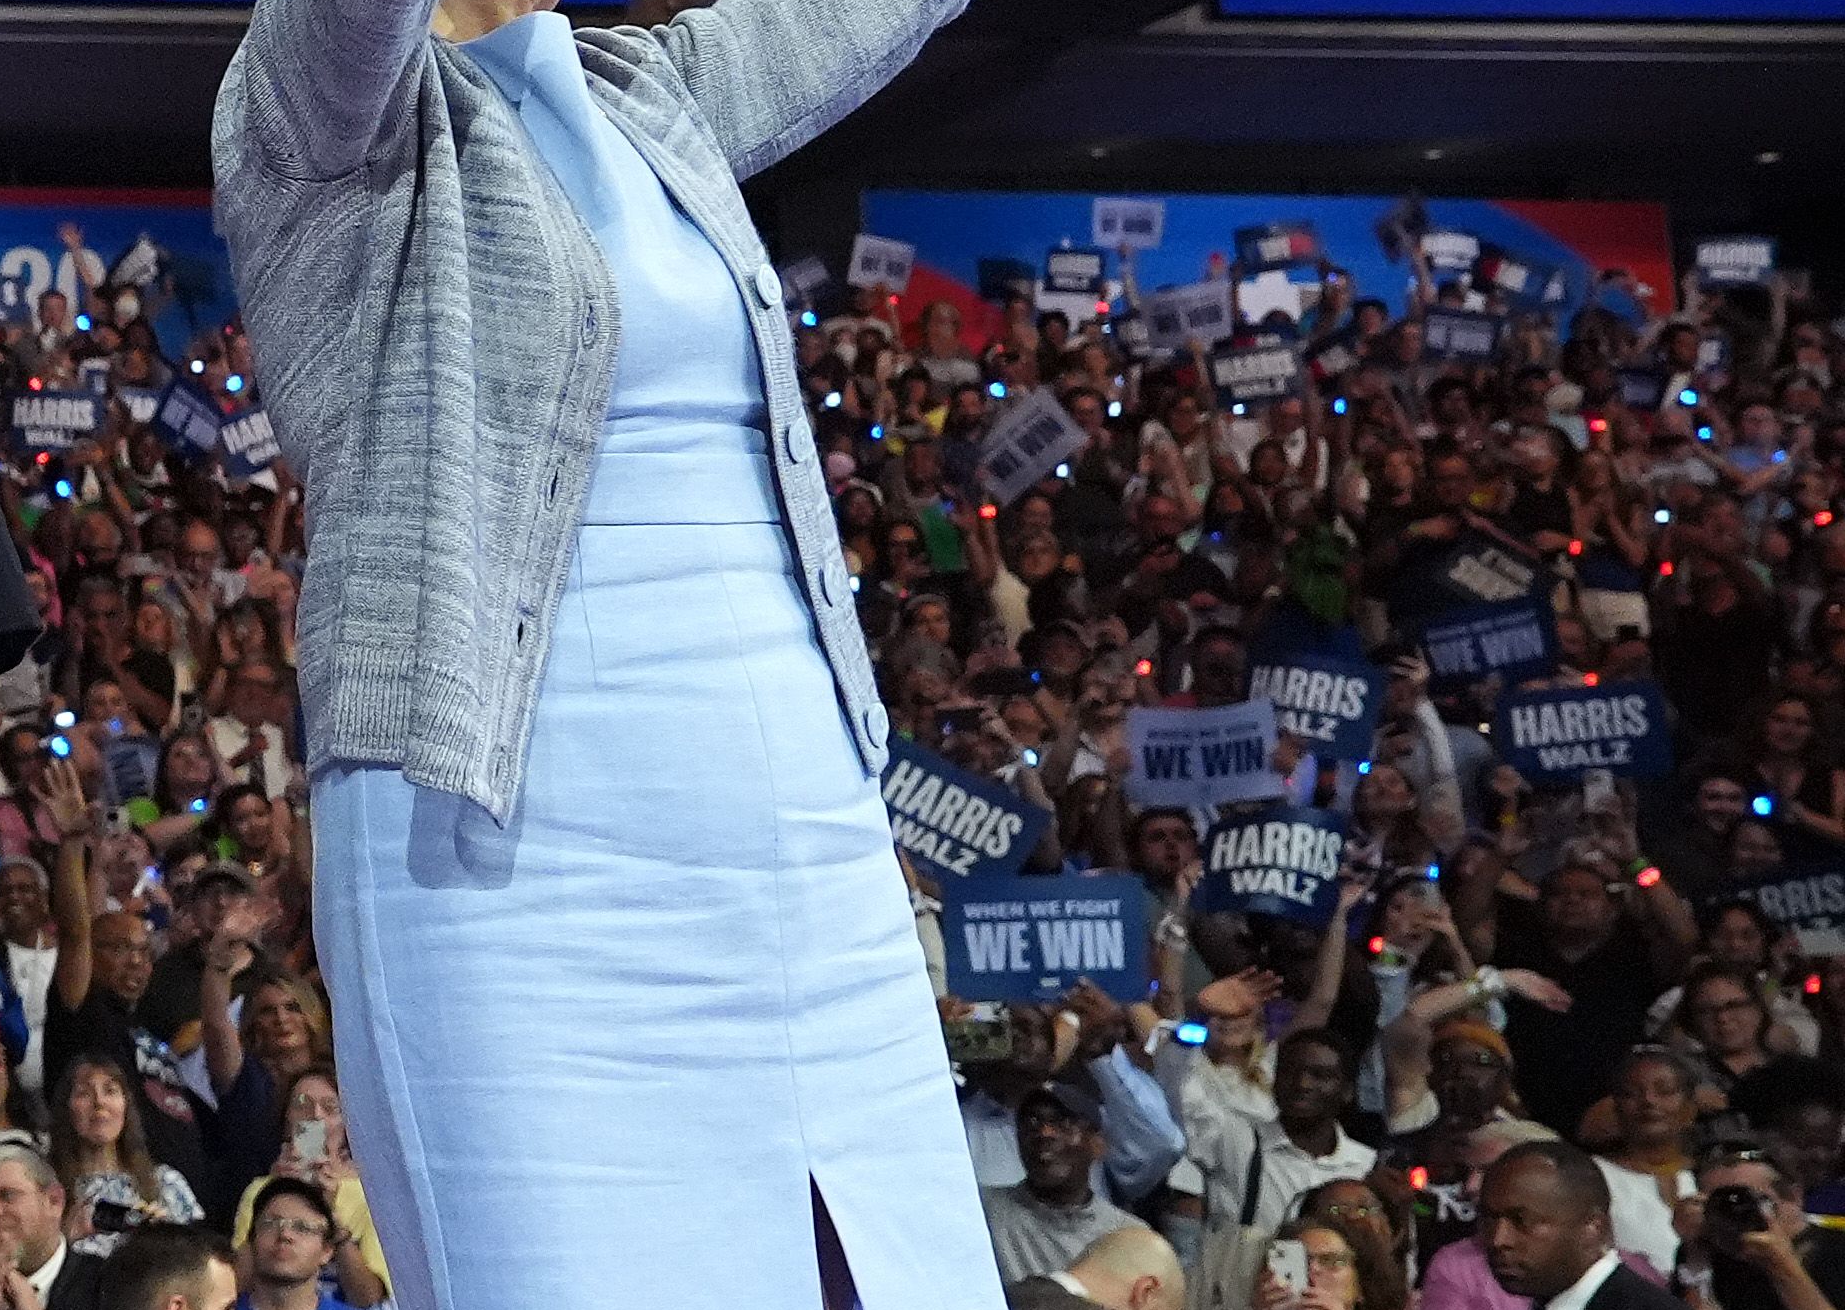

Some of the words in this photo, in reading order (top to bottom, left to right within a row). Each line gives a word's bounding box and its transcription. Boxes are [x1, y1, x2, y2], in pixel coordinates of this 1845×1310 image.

[1274, 711, 1340, 742] ALZ
[1510, 693, 1650, 749] HARRIS
[1143, 743, 1192, 780] WE
[1200, 736, 1264, 778] WIN
[882, 758, 1024, 859] HARRIS
[890, 812, 980, 877] WALZ
[1210, 821, 1343, 881] HARRIS
[1027, 900, 1061, 918] WE
[1229, 867, 1320, 907] WALZ
[1756, 872, 1845, 921] RRIS
[963, 921, 1031, 974] WE
[1036, 918, 1126, 972] WIN
